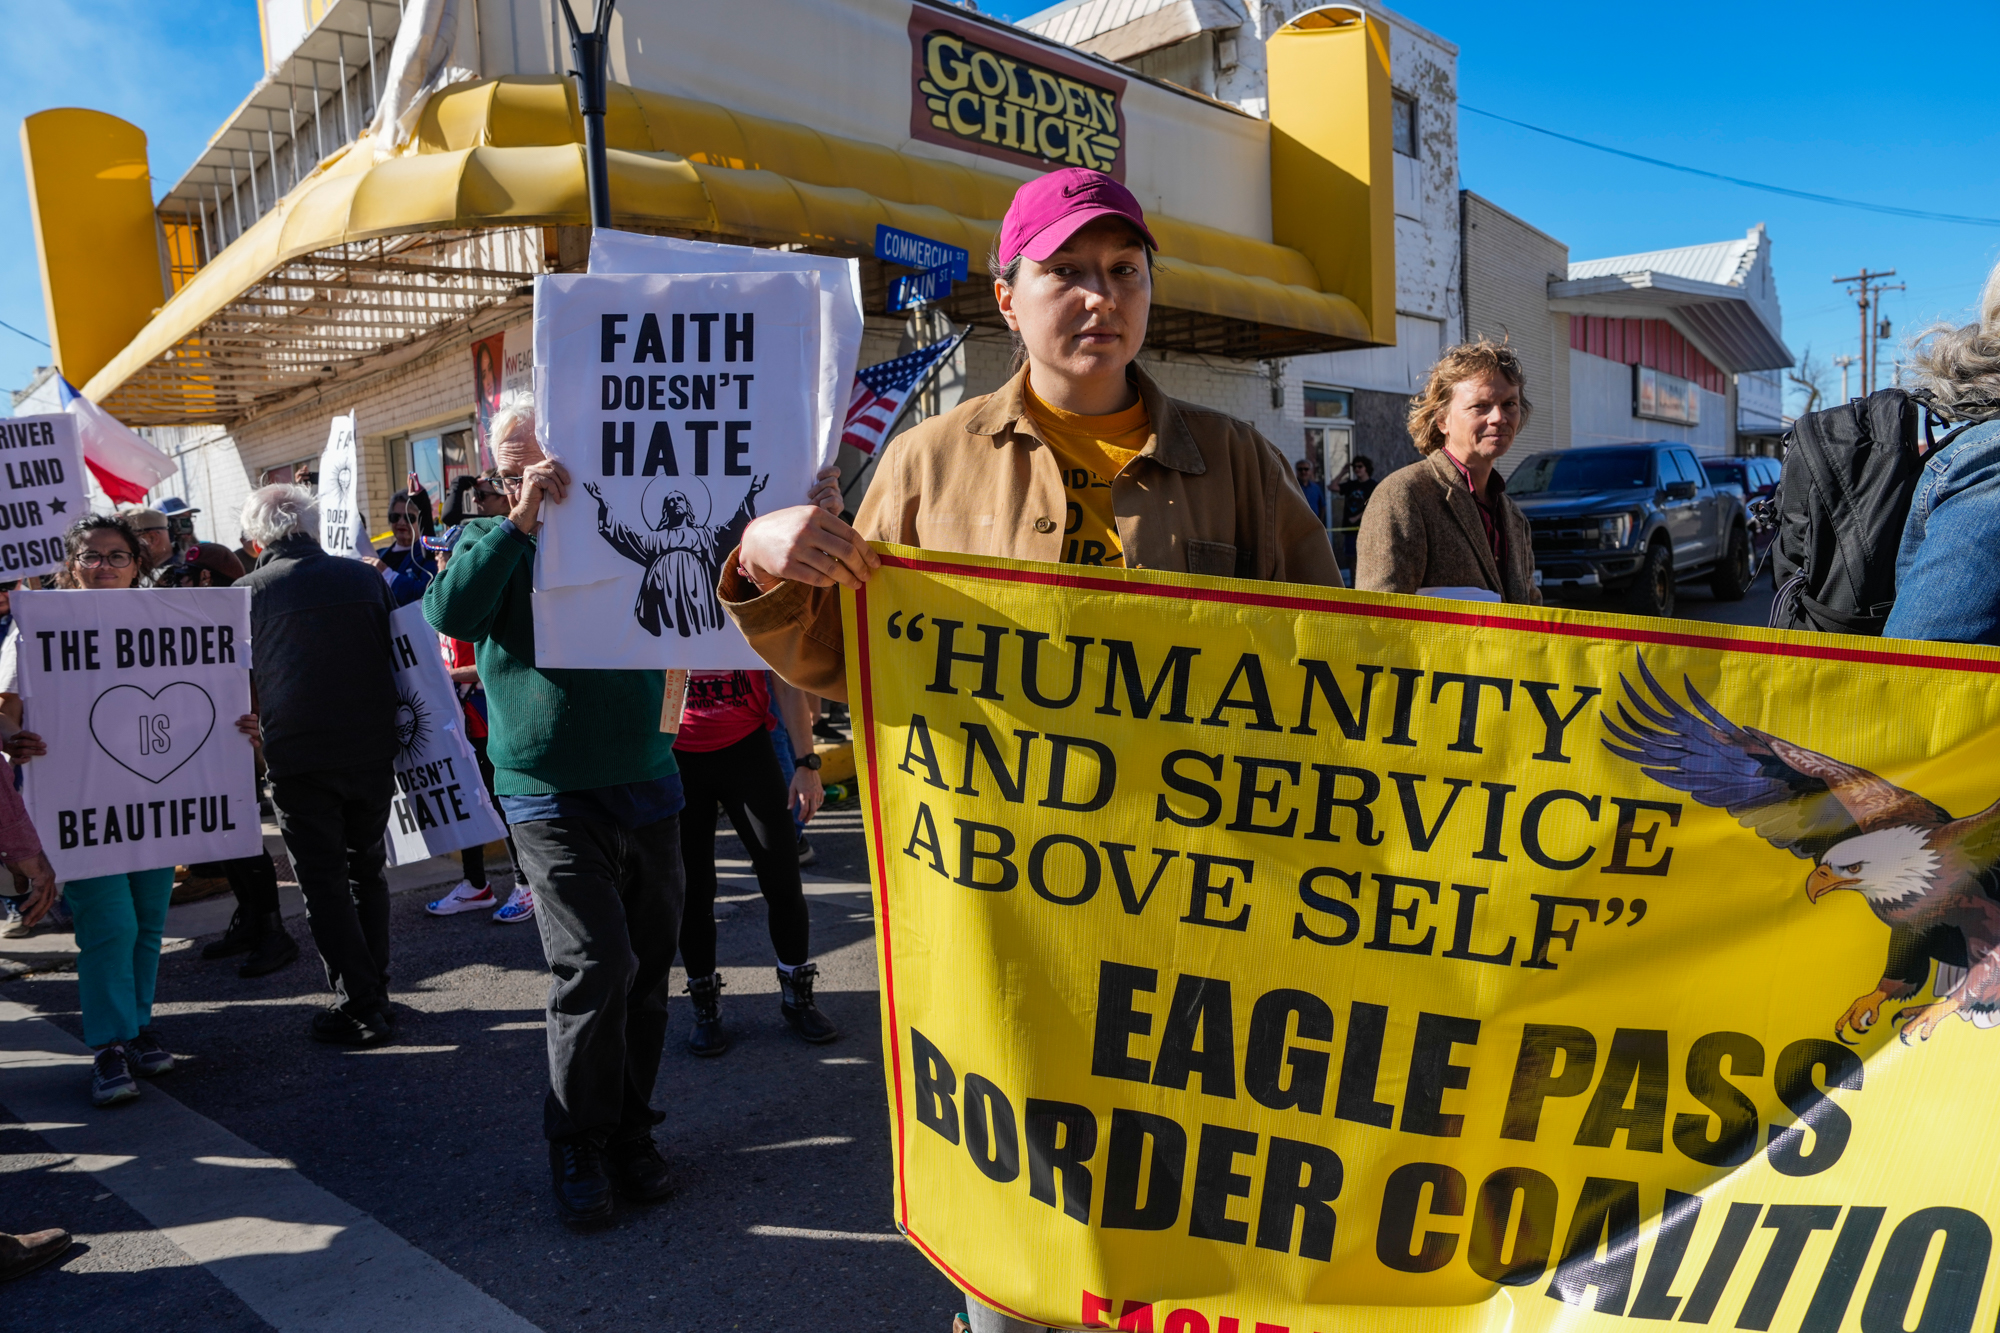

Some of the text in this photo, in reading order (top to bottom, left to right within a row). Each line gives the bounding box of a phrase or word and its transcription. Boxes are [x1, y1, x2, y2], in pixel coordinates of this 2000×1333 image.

[927, 34, 1118, 134] GOLDEN
[948, 90, 1100, 170] CHICK
[898, 272, 936, 303] MAIN
[600, 312, 754, 363] FAITH
[602, 371, 755, 411] DOESN'T
[5, 457, 65, 490] LAND
[601, 420, 752, 477] HATE
[0, 536, 65, 573] CISIO
[36, 624, 236, 672] THE BORDER
[139, 713, 171, 755] IS
[394, 783, 471, 835] HATE
[897, 713, 1683, 878] AND SERVICE
[58, 795, 237, 850] BEAUTIFUL
[901, 802, 1255, 933] ABOVE
[1090, 960, 1866, 1178] EAGLE PASS
[908, 1025, 2000, 1333] BORDER COALITIO
